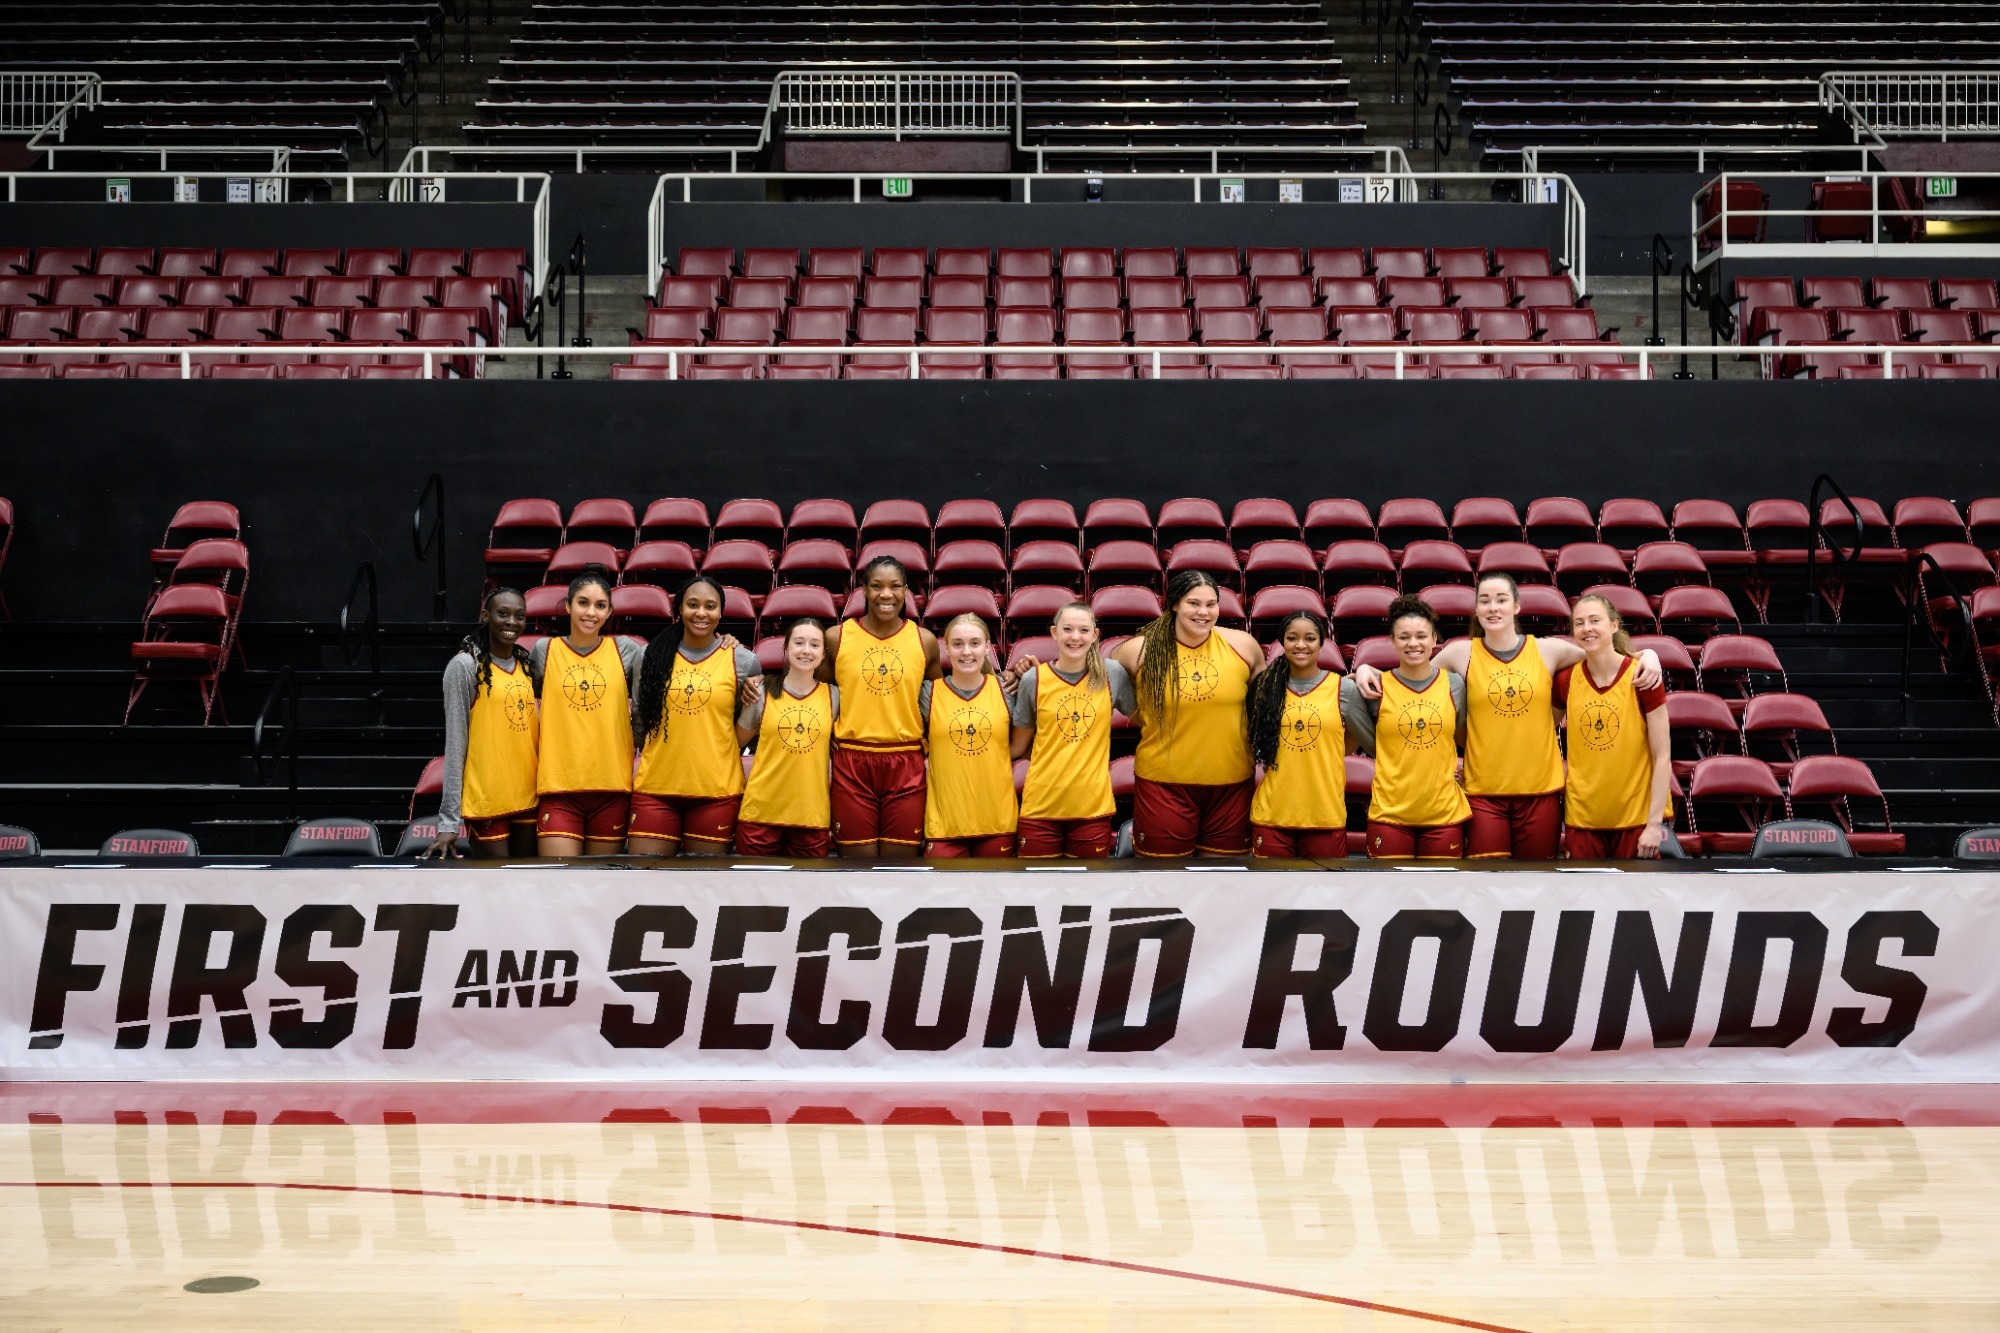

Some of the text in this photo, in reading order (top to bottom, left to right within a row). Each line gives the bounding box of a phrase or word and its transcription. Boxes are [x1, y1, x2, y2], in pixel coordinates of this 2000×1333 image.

[423, 186, 441, 203] 12
[887, 178, 908, 195] EXIT
[1372, 186, 1390, 203] 12
[1931, 177, 1953, 195] EXIT
[301, 826, 370, 841] STANFORD
[1764, 828, 1837, 845] STANFORD
[111, 837, 188, 854] STANFORD
[28, 904, 1940, 1053] FIRST AND SECOND ROUNDS
